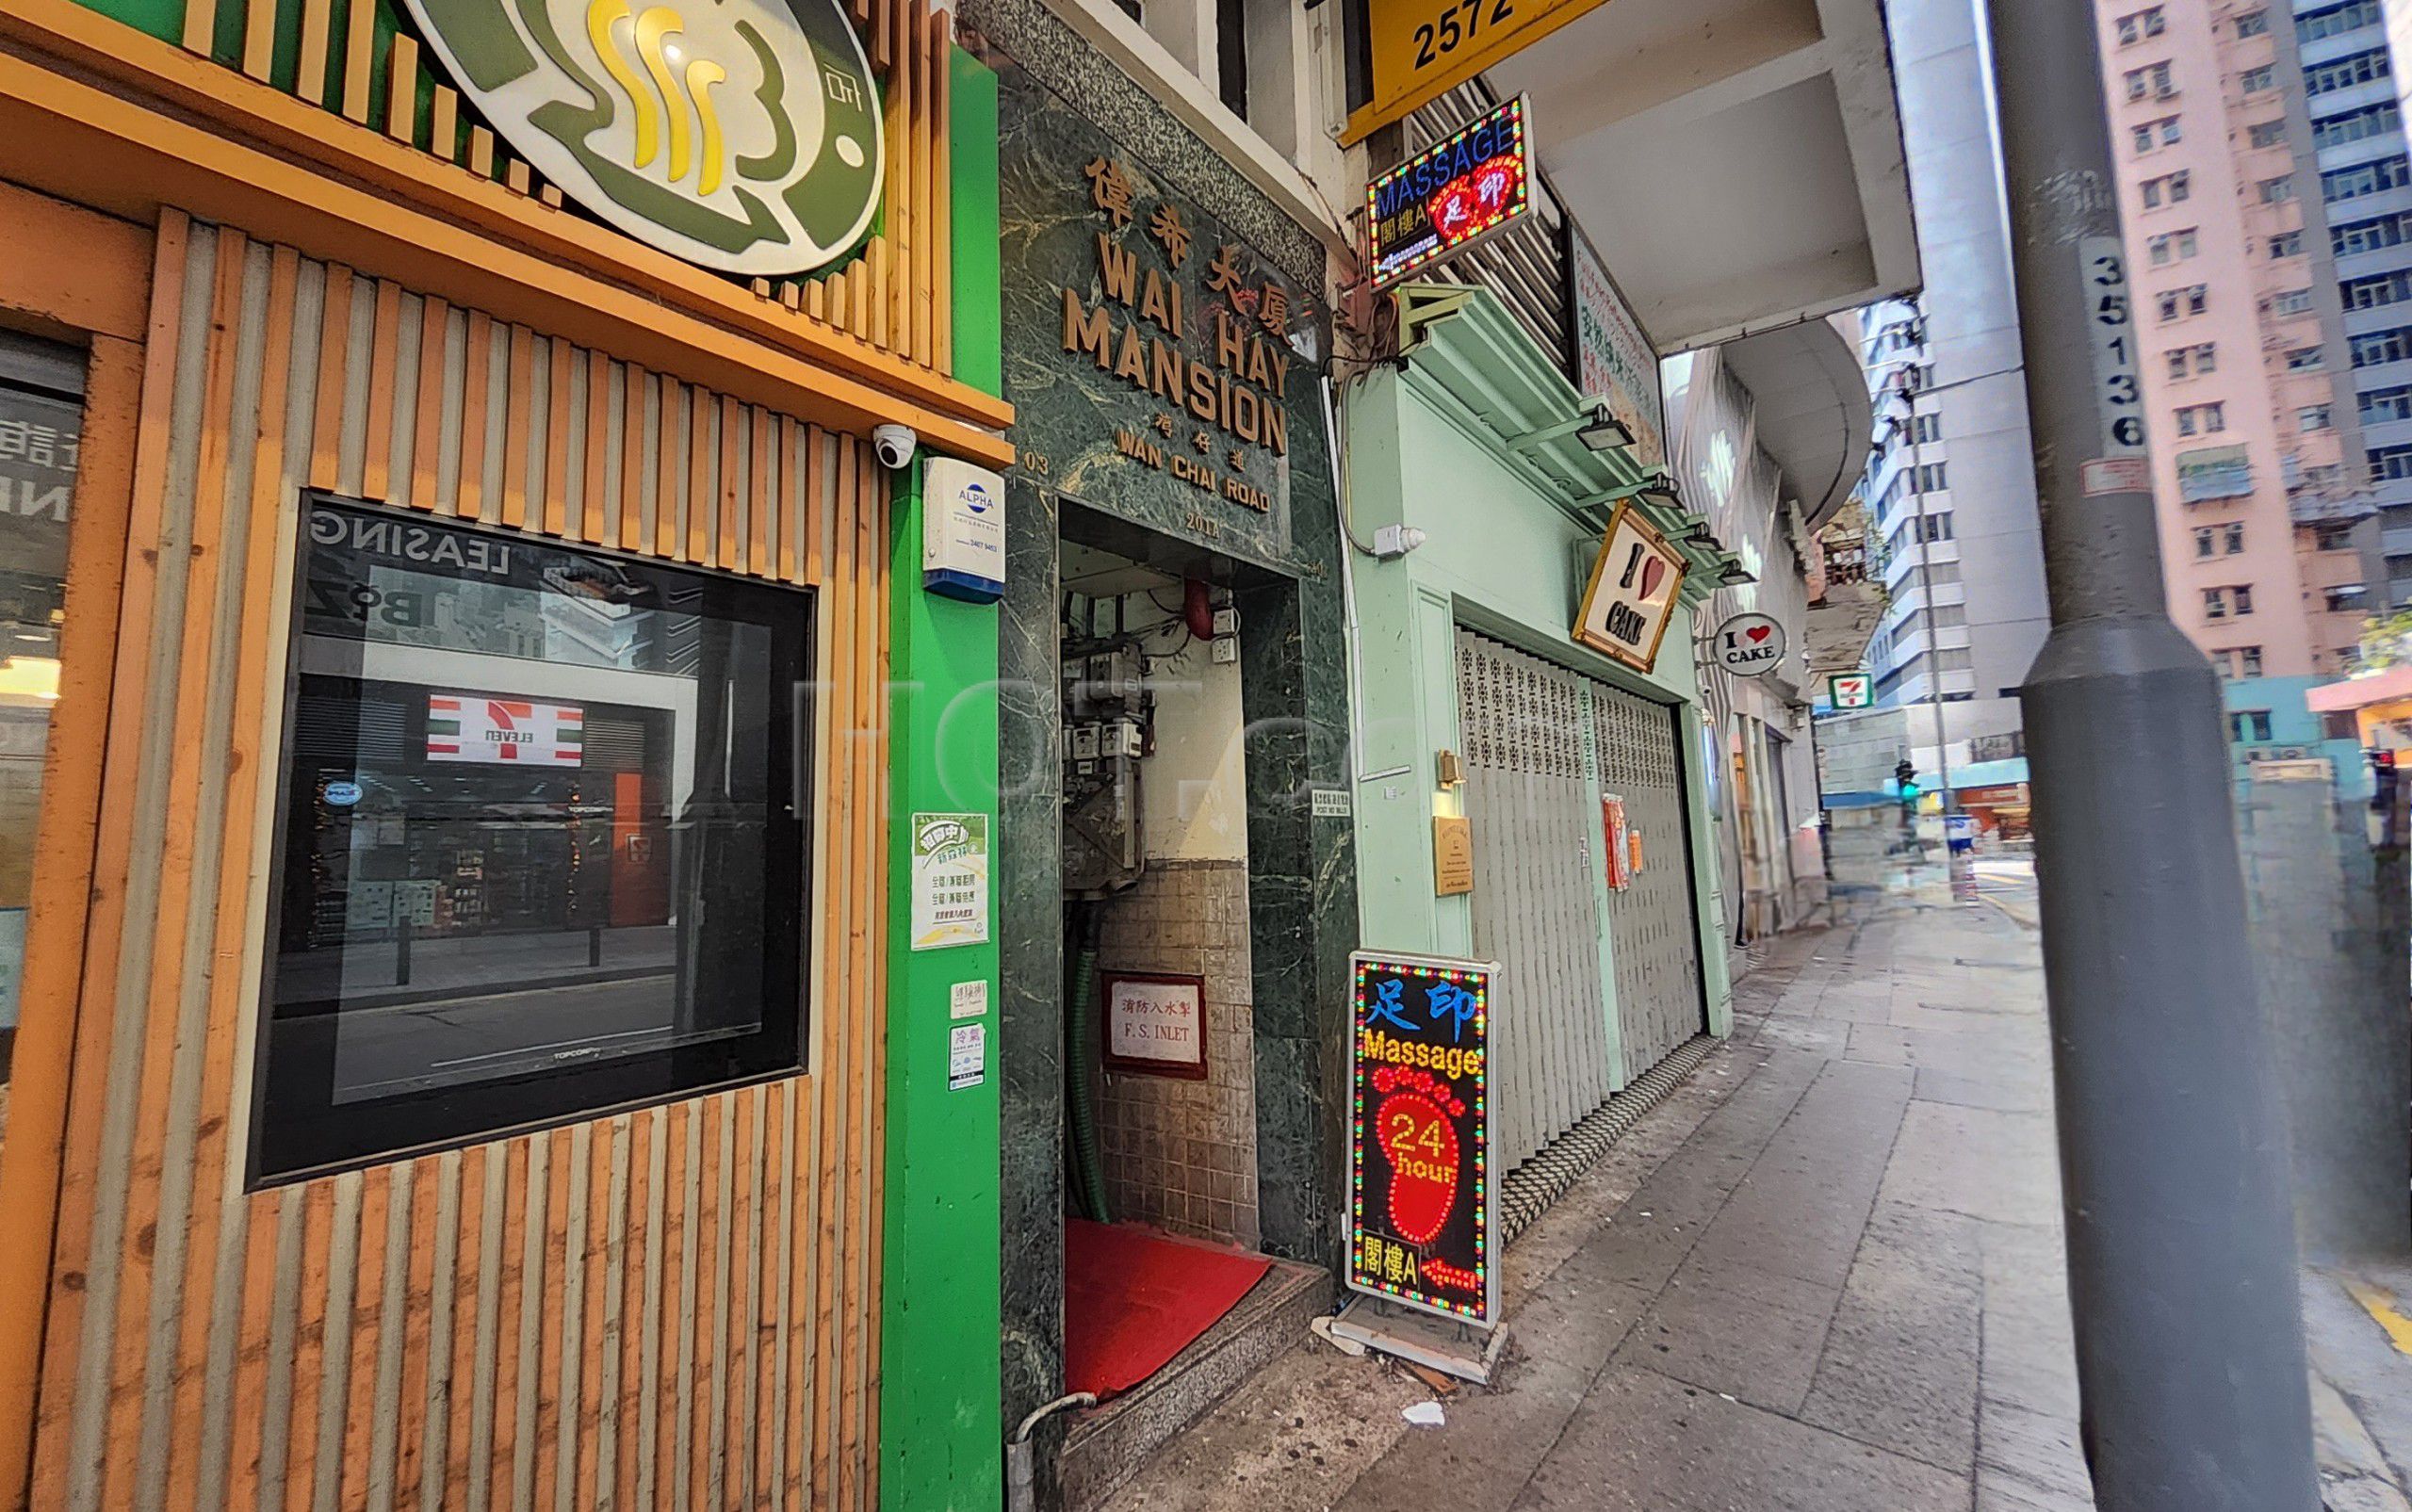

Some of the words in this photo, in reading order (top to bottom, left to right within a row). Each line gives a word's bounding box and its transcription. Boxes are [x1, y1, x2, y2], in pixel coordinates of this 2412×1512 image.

[1376, 115, 1514, 219] MASSAGE
[1442, 171, 1506, 230] 足印
[1098, 232, 1183, 340] WAI
[1216, 309, 1290, 399] HAY
[1062, 287, 1287, 458] MANSION
[2093, 255, 2144, 447] 35136
[1116, 429, 1163, 469] WAN
[1169, 454, 1217, 492] CHAI
[1224, 477, 1271, 513] ROAD
[959, 490, 994, 509] ALPHA
[1186, 512, 1220, 539] 201A
[1723, 632, 1737, 649] I
[1726, 645, 1775, 664] CAKE
[1121, 998, 1191, 1017] 消防入水掣
[1365, 978, 1476, 1043] 足印
[1155, 1024, 1189, 1042] INLET
[1363, 1028, 1481, 1081] Massage
[1391, 1113, 1445, 1158] 24
[1395, 1152, 1457, 1184] hour
[1363, 1236, 1418, 1285] 閣樓A
